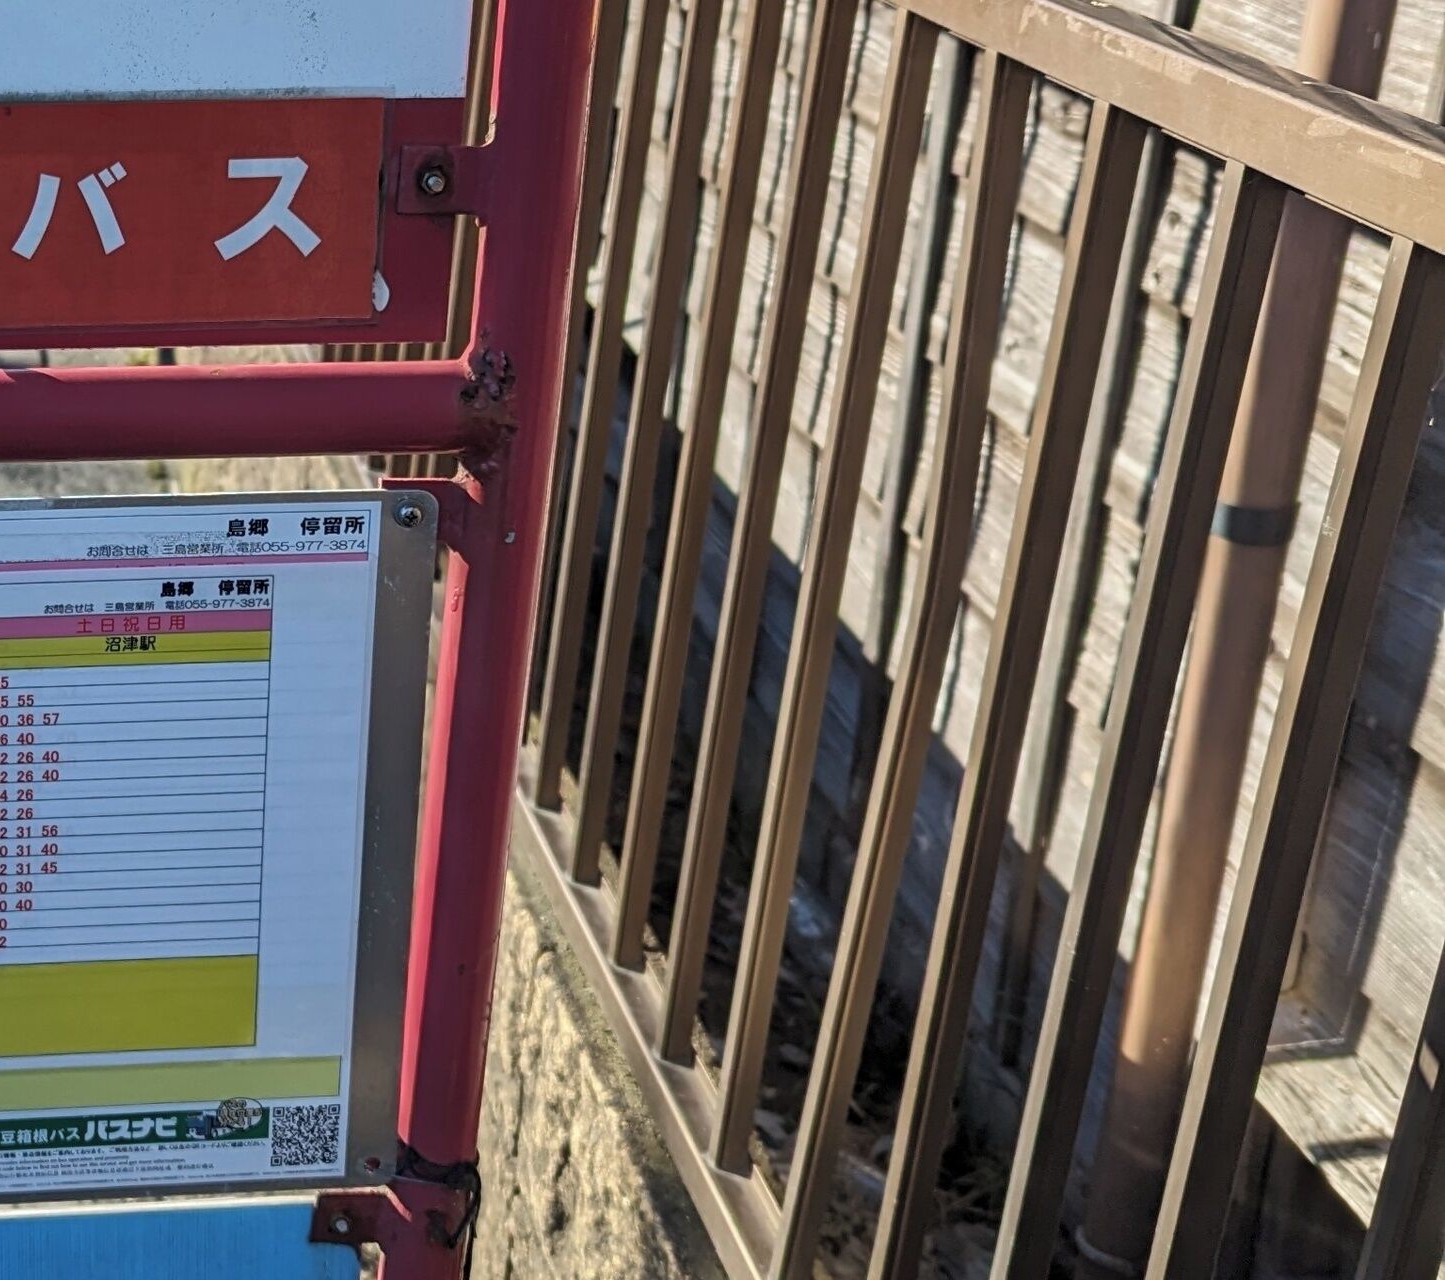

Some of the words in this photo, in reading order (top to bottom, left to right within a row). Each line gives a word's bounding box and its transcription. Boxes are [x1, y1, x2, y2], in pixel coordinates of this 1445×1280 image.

[227, 518, 269, 538] 島郷
[300, 516, 365, 536] 停留所
[86, 544, 149, 557] お問合せは
[162, 543, 224, 555] 三島営業所
[161, 581, 194, 598] 島郷
[218, 579, 269, 595] 停留所
[76, 615, 186, 633] 土日祝日用
[105, 635, 157, 652] 沼津駅
[18, 695, 34, 707] 55
[17, 714, 34, 726] 36
[43, 713, 59, 725] 57
[17, 733, 34, 745] 40
[17, 752, 34, 763] 26
[42, 751, 59, 762] 40
[17, 771, 33, 782] 26
[42, 770, 59, 781] 40
[17, 789, 33, 801] 26
[17, 808, 33, 819] 26
[16, 827, 31, 838] 31
[42, 825, 58, 837] 56
[16, 845, 31, 857] 31
[41, 843, 58, 855] 40
[16, 863, 31, 875] 31
[41, 862, 57, 874] 45
[16, 881, 32, 893] 30
[16, 900, 32, 911] 40
[84, 1116, 178, 1142] バスナビ
